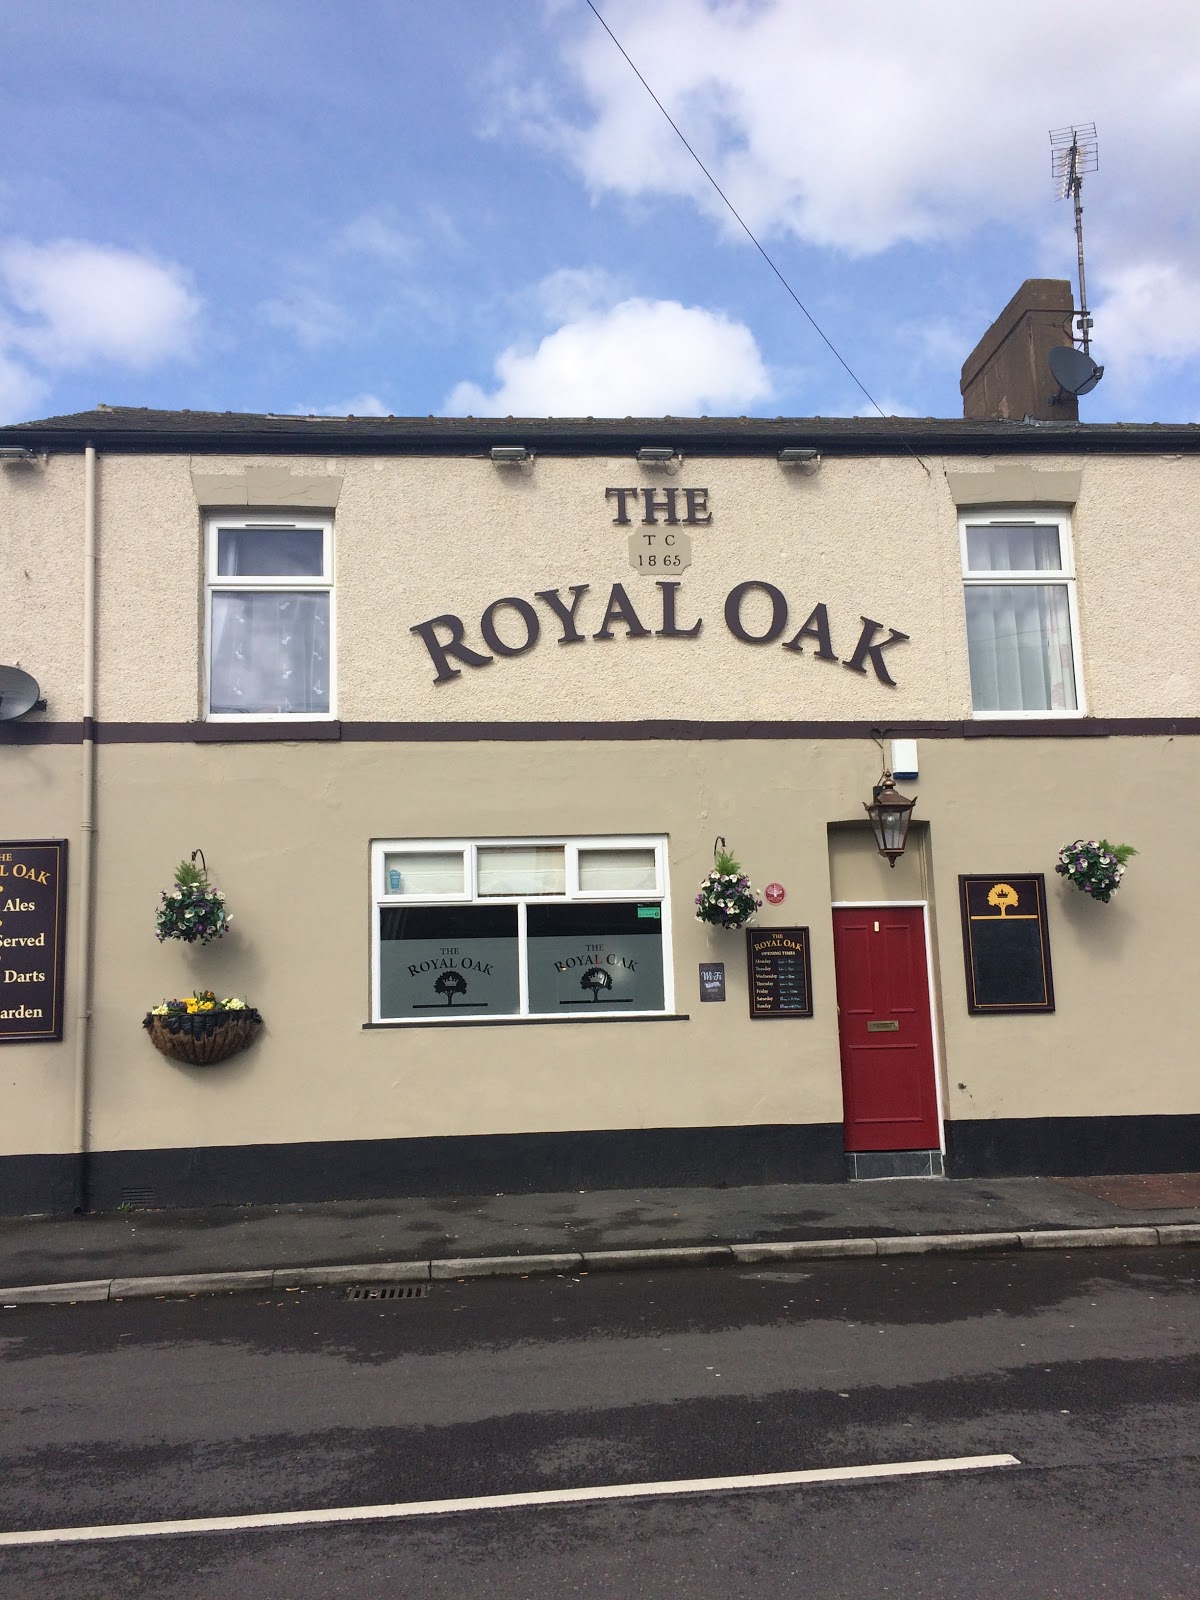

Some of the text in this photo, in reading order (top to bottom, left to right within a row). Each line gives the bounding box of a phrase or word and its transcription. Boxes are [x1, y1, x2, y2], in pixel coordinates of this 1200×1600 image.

[605, 487, 712, 523] THE
[643, 534, 675, 546] T C
[639, 555, 681, 567] 1865
[410, 580, 910, 687] ROYAL OAK
[13, 863, 51, 886] OAK
[3, 898, 36, 912] Ales
[440, 947, 460, 955] THE
[585, 944, 605, 952] THE
[754, 939, 802, 951] ROYAL OAK
[407, 957, 494, 977] ROYAL OAK
[553, 954, 602, 973] ROYAL
[4, 970, 46, 983] Darts
